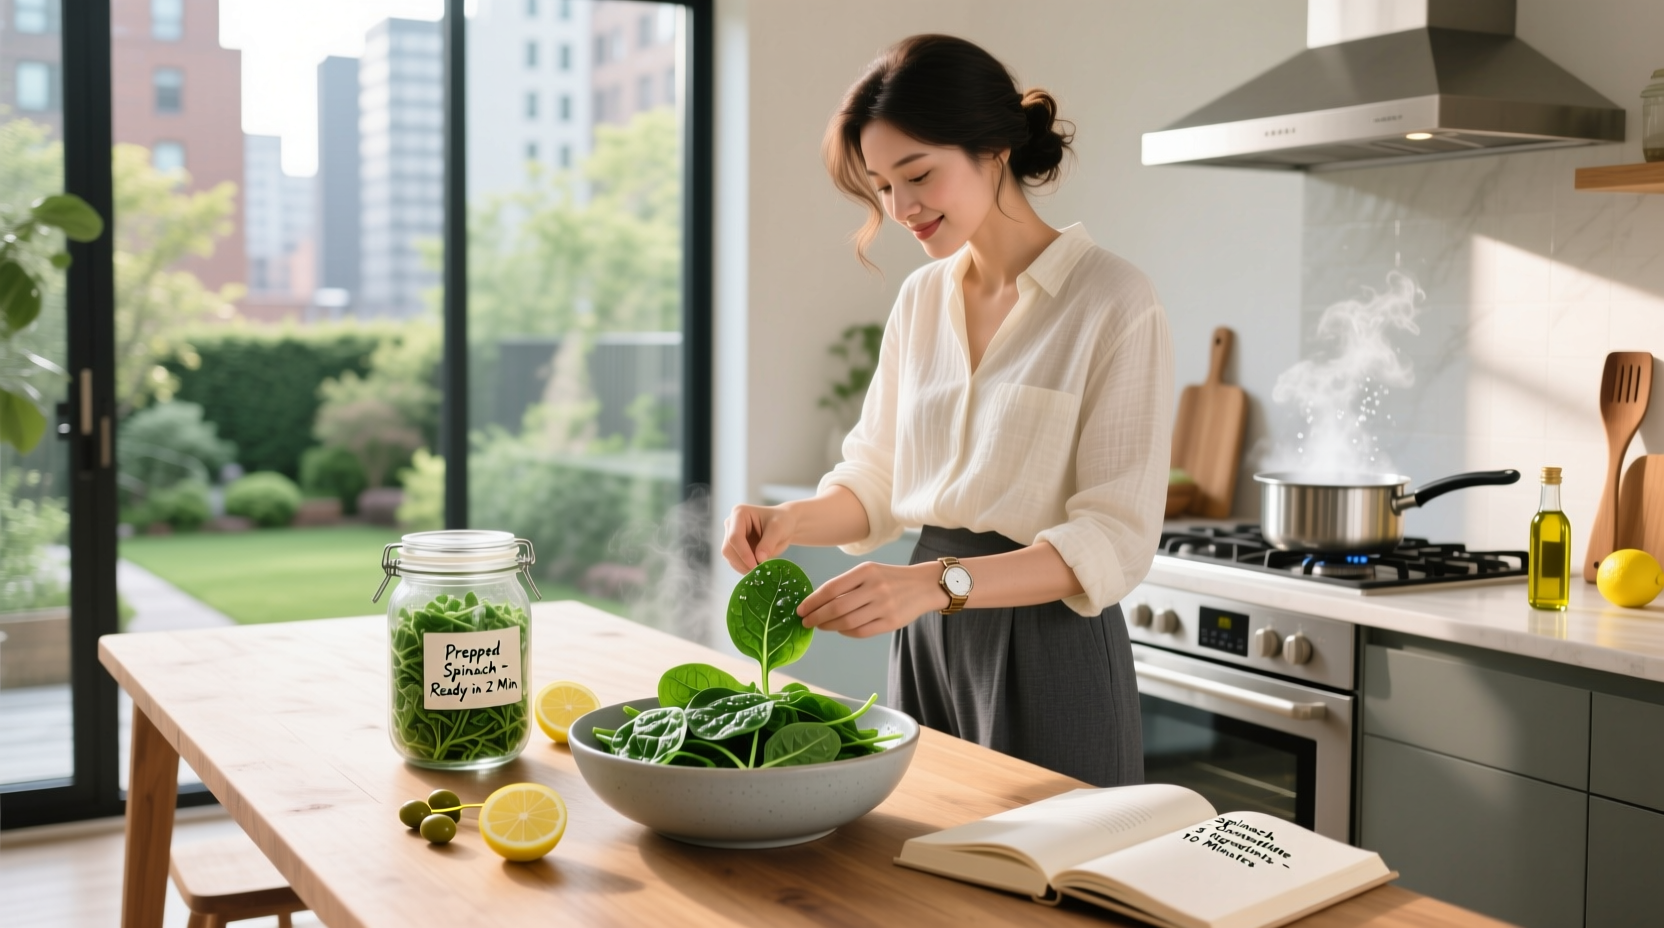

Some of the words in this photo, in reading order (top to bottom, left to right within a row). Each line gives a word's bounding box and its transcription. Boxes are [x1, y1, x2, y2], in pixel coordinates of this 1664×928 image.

[446, 640, 500, 664] Prepped
[443, 661, 497, 682] Spinach
[430, 682, 468, 702] Ready
[472, 683, 482, 695] in
[485, 680, 494, 693] 2
[497, 677, 518, 692] Min
